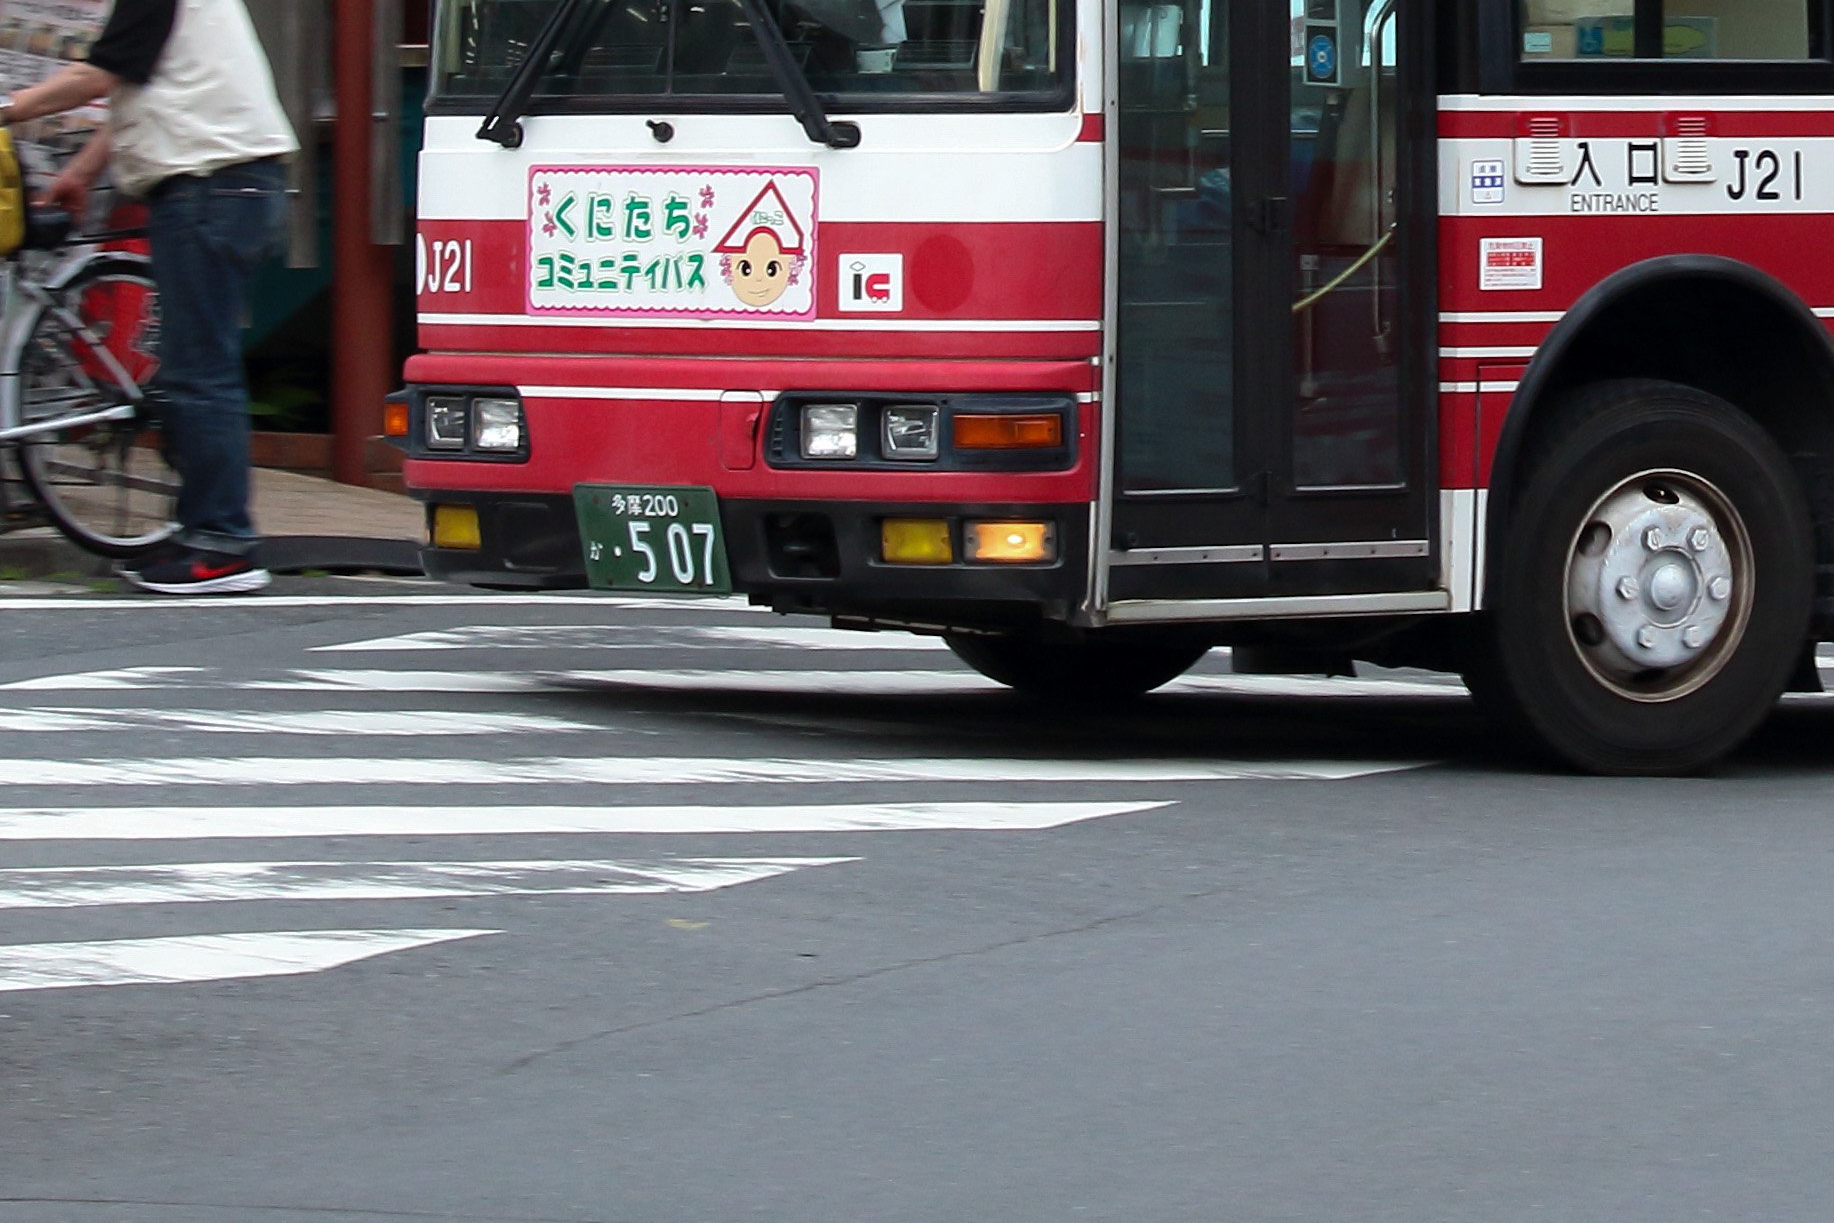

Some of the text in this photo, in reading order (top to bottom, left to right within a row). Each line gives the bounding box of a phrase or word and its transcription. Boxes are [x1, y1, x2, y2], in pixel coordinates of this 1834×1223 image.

[1570, 141, 1660, 187] 入口
[1726, 148, 1802, 201] J21
[553, 193, 694, 241] くにたち
[1570, 193, 1660, 213] ENTRANCE
[427, 238, 472, 294] J21
[536, 251, 707, 292] コミュニティバス
[611, 493, 679, 517] 多摩200
